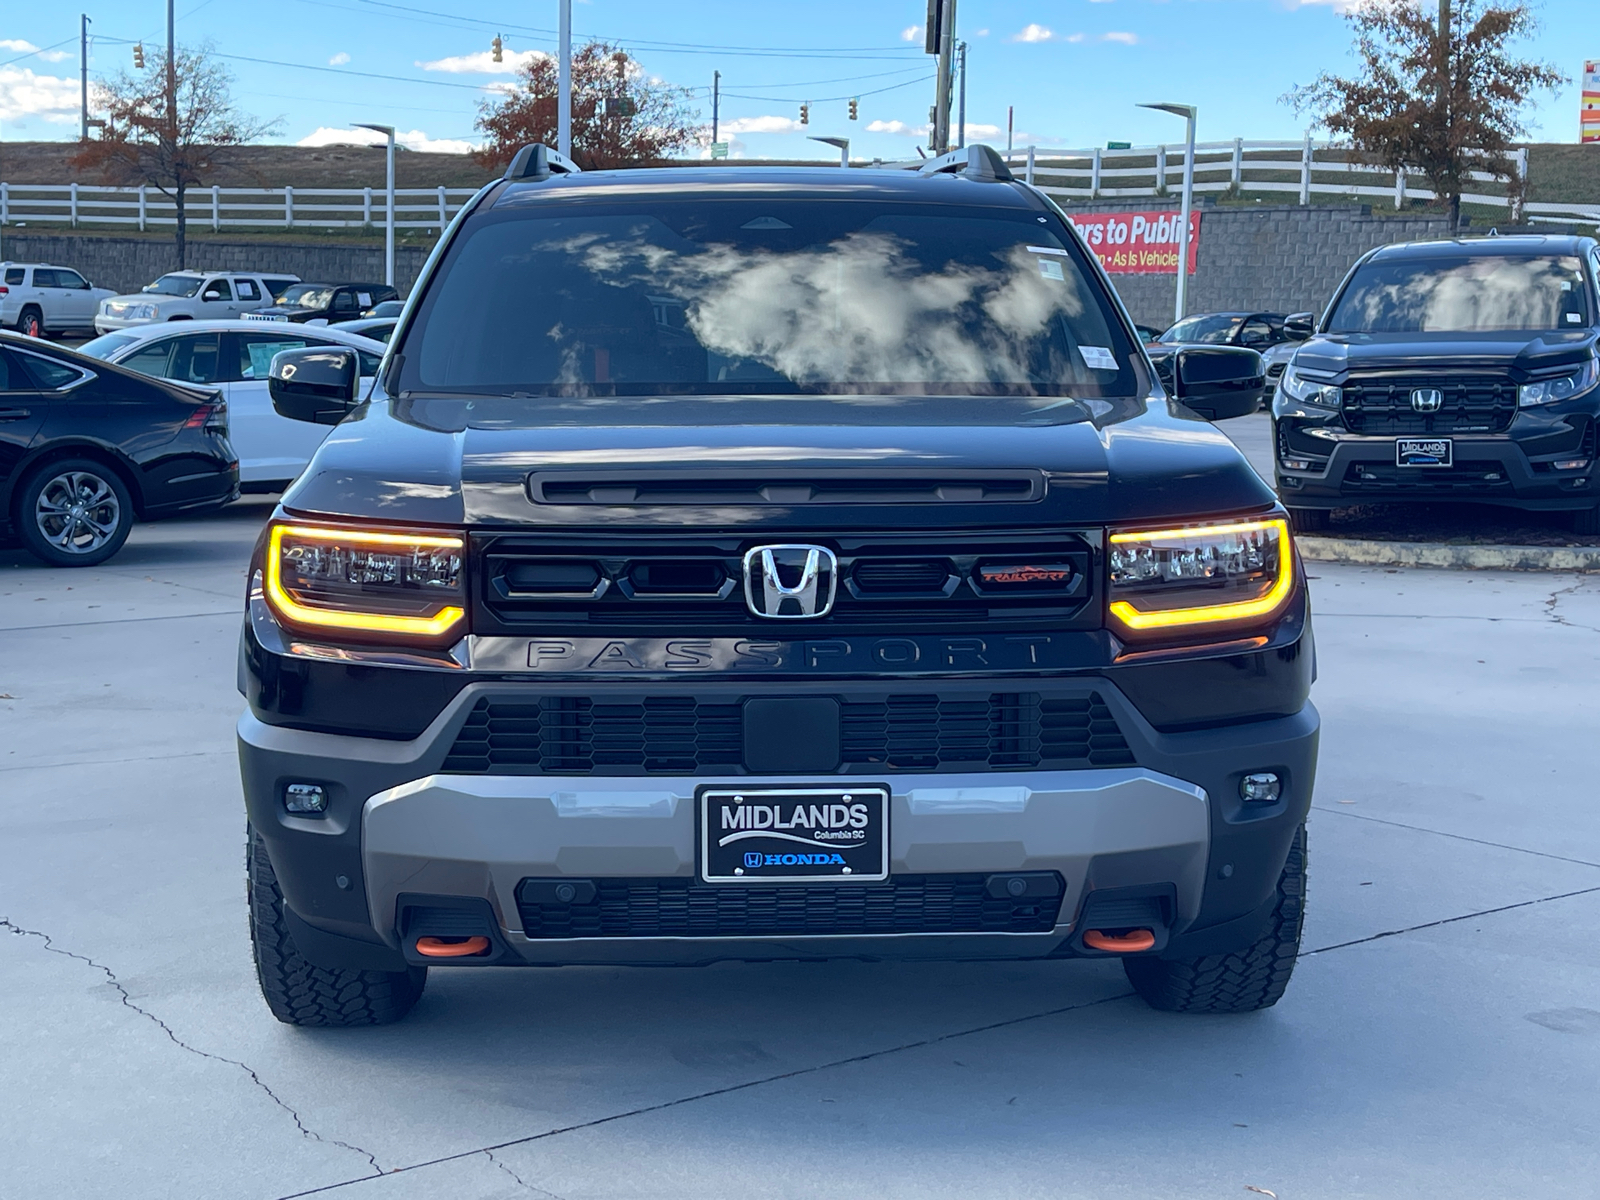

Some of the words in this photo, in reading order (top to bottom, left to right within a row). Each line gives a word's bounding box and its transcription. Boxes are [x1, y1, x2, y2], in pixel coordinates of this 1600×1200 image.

[1106, 218, 1128, 245] to
[1112, 251, 1127, 266] As
[1128, 250, 1138, 266] Is
[1401, 443, 1446, 452] MIDLANDS
[983, 571, 1069, 583] TRAILSPORT
[527, 636, 1051, 668] PASSPORT
[721, 804, 868, 830] MIDLANDS
[814, 830, 851, 840] Columbia
[851, 830, 865, 839] SC
[764, 853, 846, 866] HONDA
